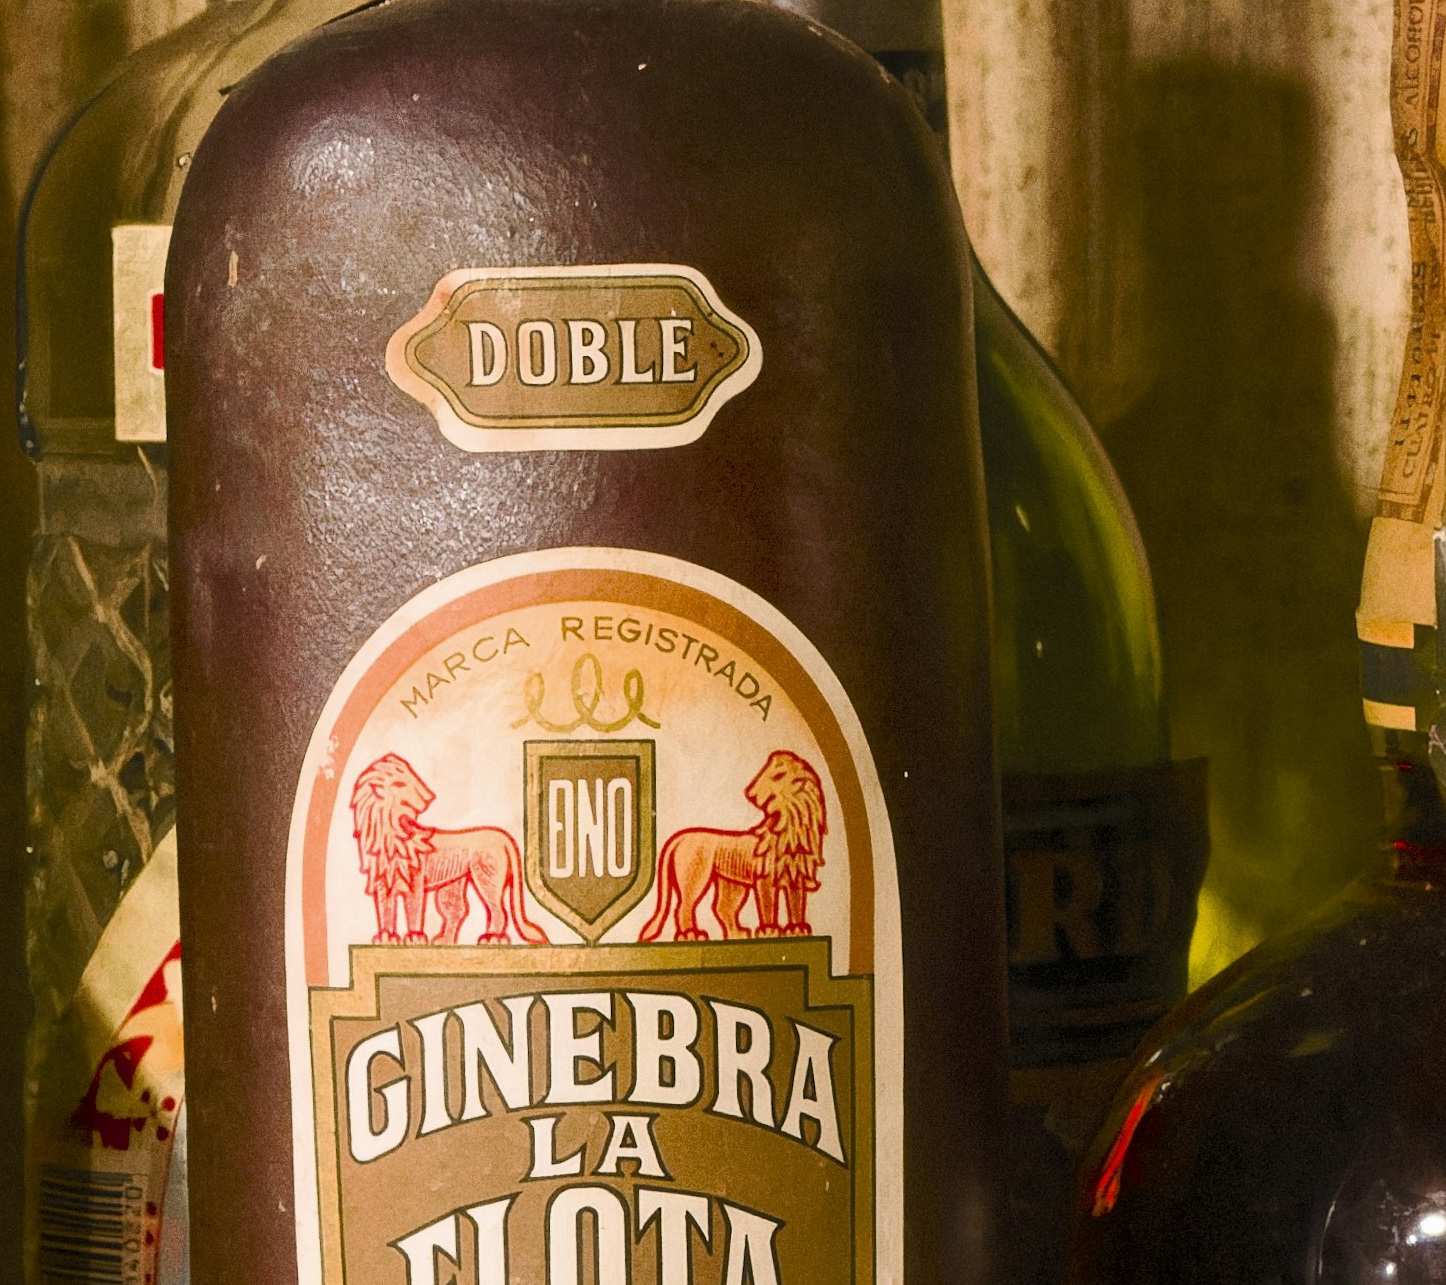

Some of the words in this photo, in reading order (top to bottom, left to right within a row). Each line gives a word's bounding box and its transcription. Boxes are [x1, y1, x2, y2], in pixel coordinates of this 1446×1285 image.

[467, 318, 700, 388] DOBLE
[398, 625, 531, 720] MARCA
[560, 615, 775, 722] REGISTRADA
[345, 989, 848, 1169] GINEBRA
[520, 1113, 673, 1183] LA
